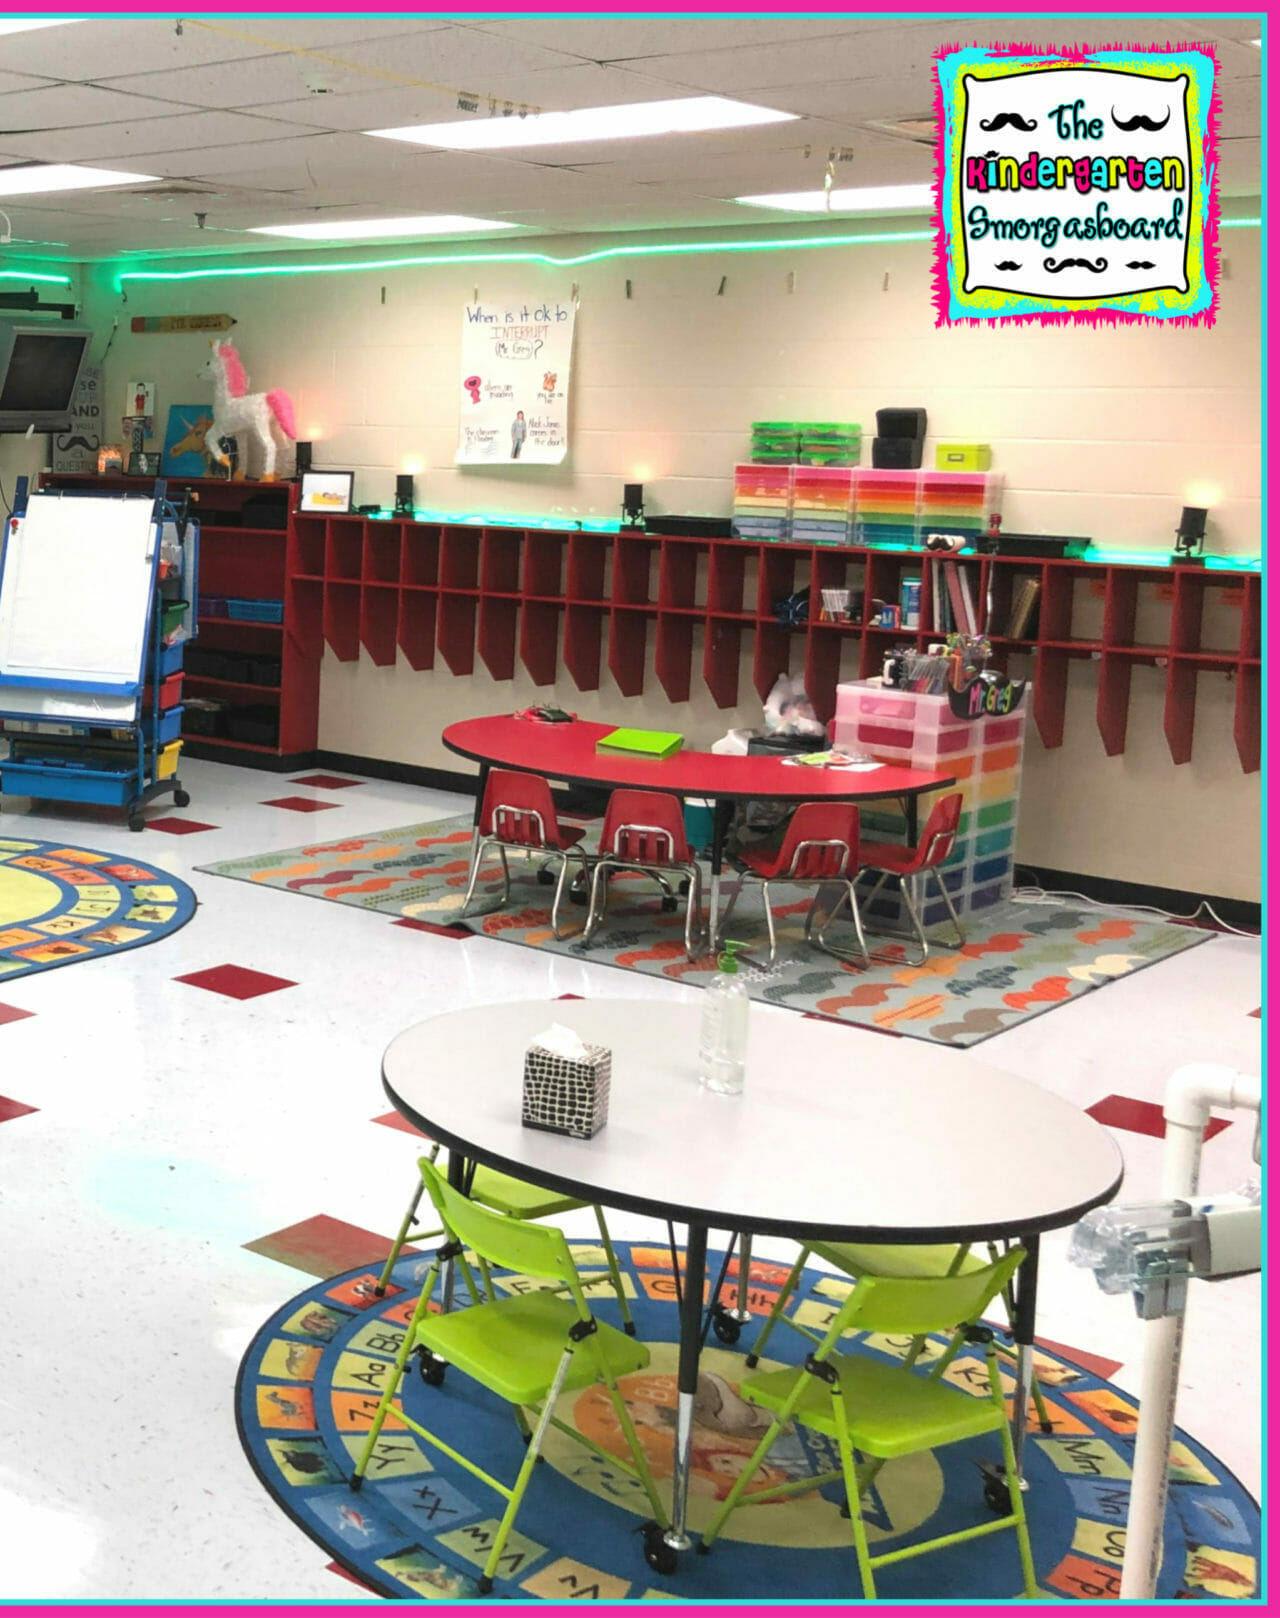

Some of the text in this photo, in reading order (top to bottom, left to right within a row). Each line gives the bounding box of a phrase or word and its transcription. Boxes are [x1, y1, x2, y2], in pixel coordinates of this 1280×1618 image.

[466, 306, 498, 323] When
[505, 311, 514, 323] is
[520, 305, 530, 322] it
[555, 304, 568, 322] to
[490, 325, 549, 340] INTERRUPT
[985, 681, 1013, 713] Greg
[366, 1332, 407, 1354] Bb
[351, 1362, 387, 1388] Aa
[368, 1444, 414, 1470] Yy
[1057, 1439, 1105, 1476] Mm
[412, 1484, 459, 1520] Xx
[1092, 1485, 1130, 1516] Nn
